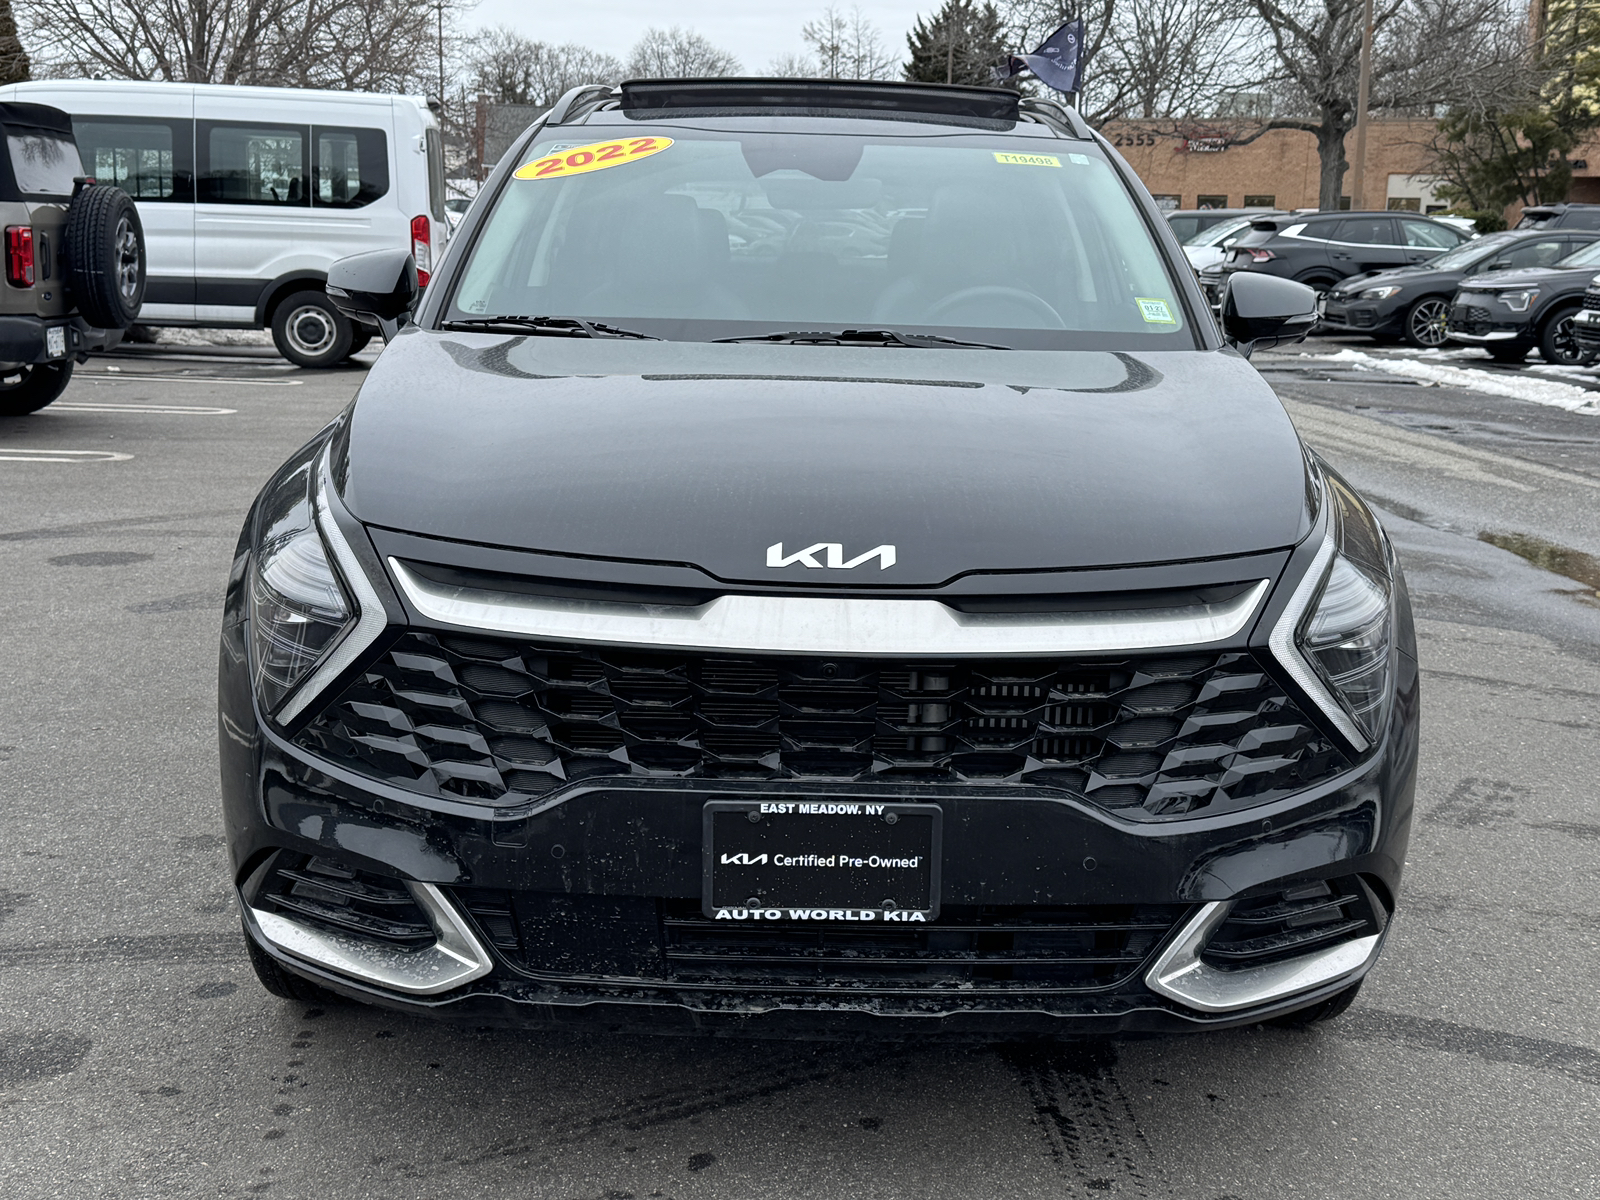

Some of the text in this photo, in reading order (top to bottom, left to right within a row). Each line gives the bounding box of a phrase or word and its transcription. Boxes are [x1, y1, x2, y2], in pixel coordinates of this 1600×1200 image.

[1115, 133, 1155, 146] 2555
[535, 138, 658, 176] 2022
[1001, 154, 1053, 165] T19498
[766, 541, 897, 571] KIA
[760, 803, 796, 814] EAST
[865, 805, 885, 816] NY
[720, 853, 769, 866] KIA
[773, 854, 836, 868] Certified
[715, 909, 926, 922] AUTO WORLD KIA
